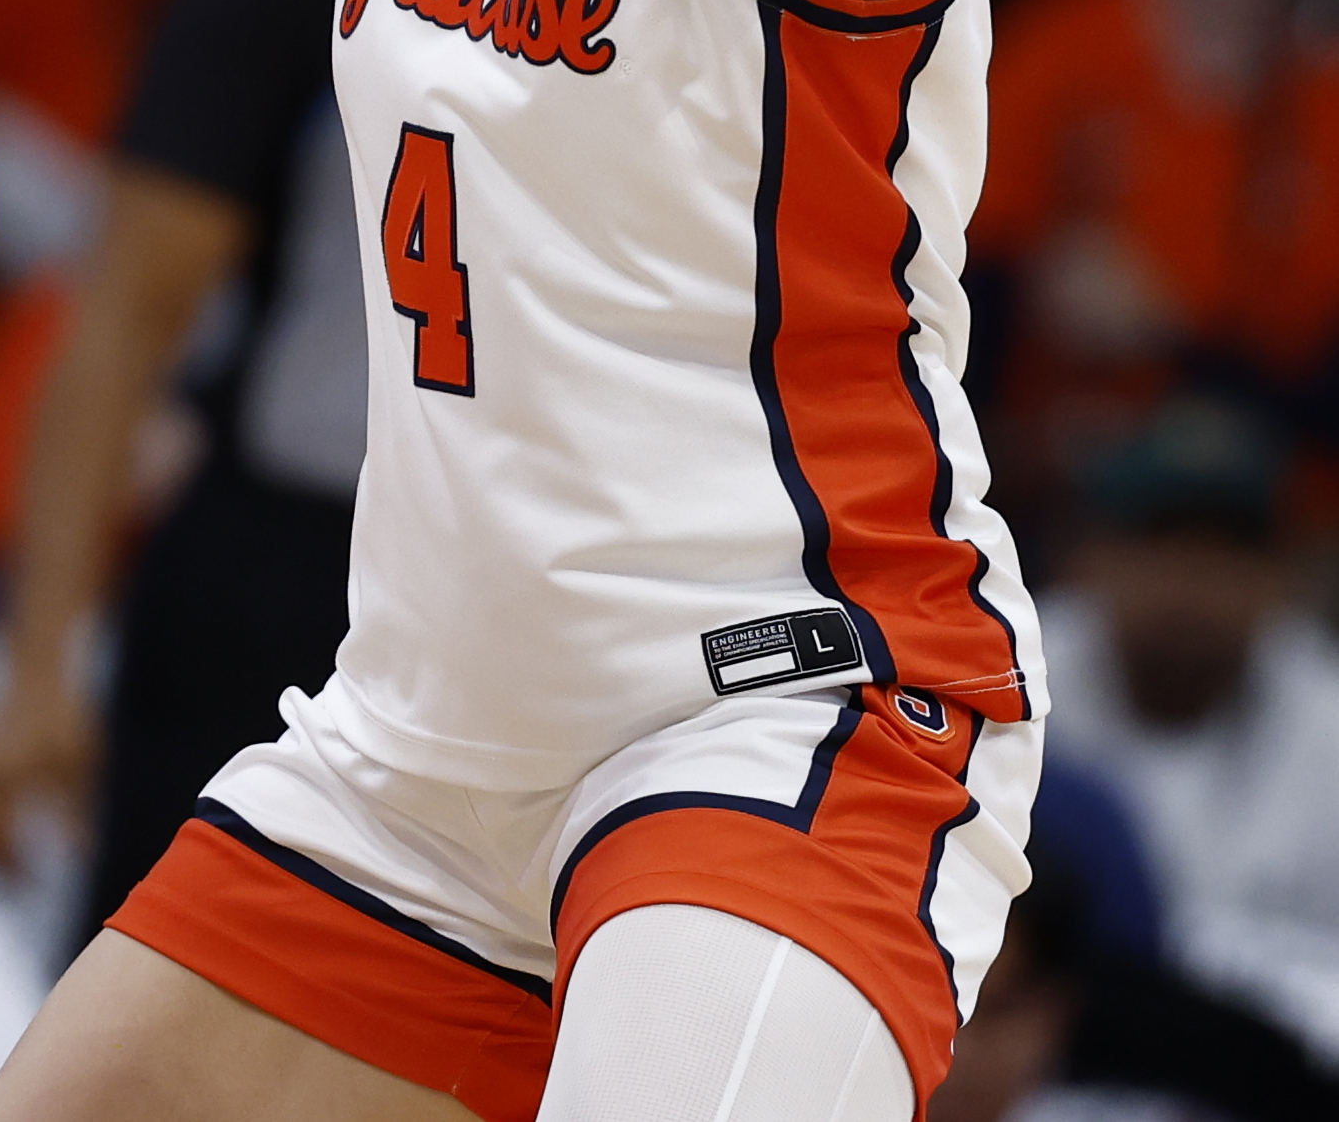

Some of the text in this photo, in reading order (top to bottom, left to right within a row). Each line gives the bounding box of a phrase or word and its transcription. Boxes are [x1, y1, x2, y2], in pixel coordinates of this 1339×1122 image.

[381, 121, 475, 397] 4
[711, 624, 786, 648] ENGINEERED
[811, 629, 835, 653] L
